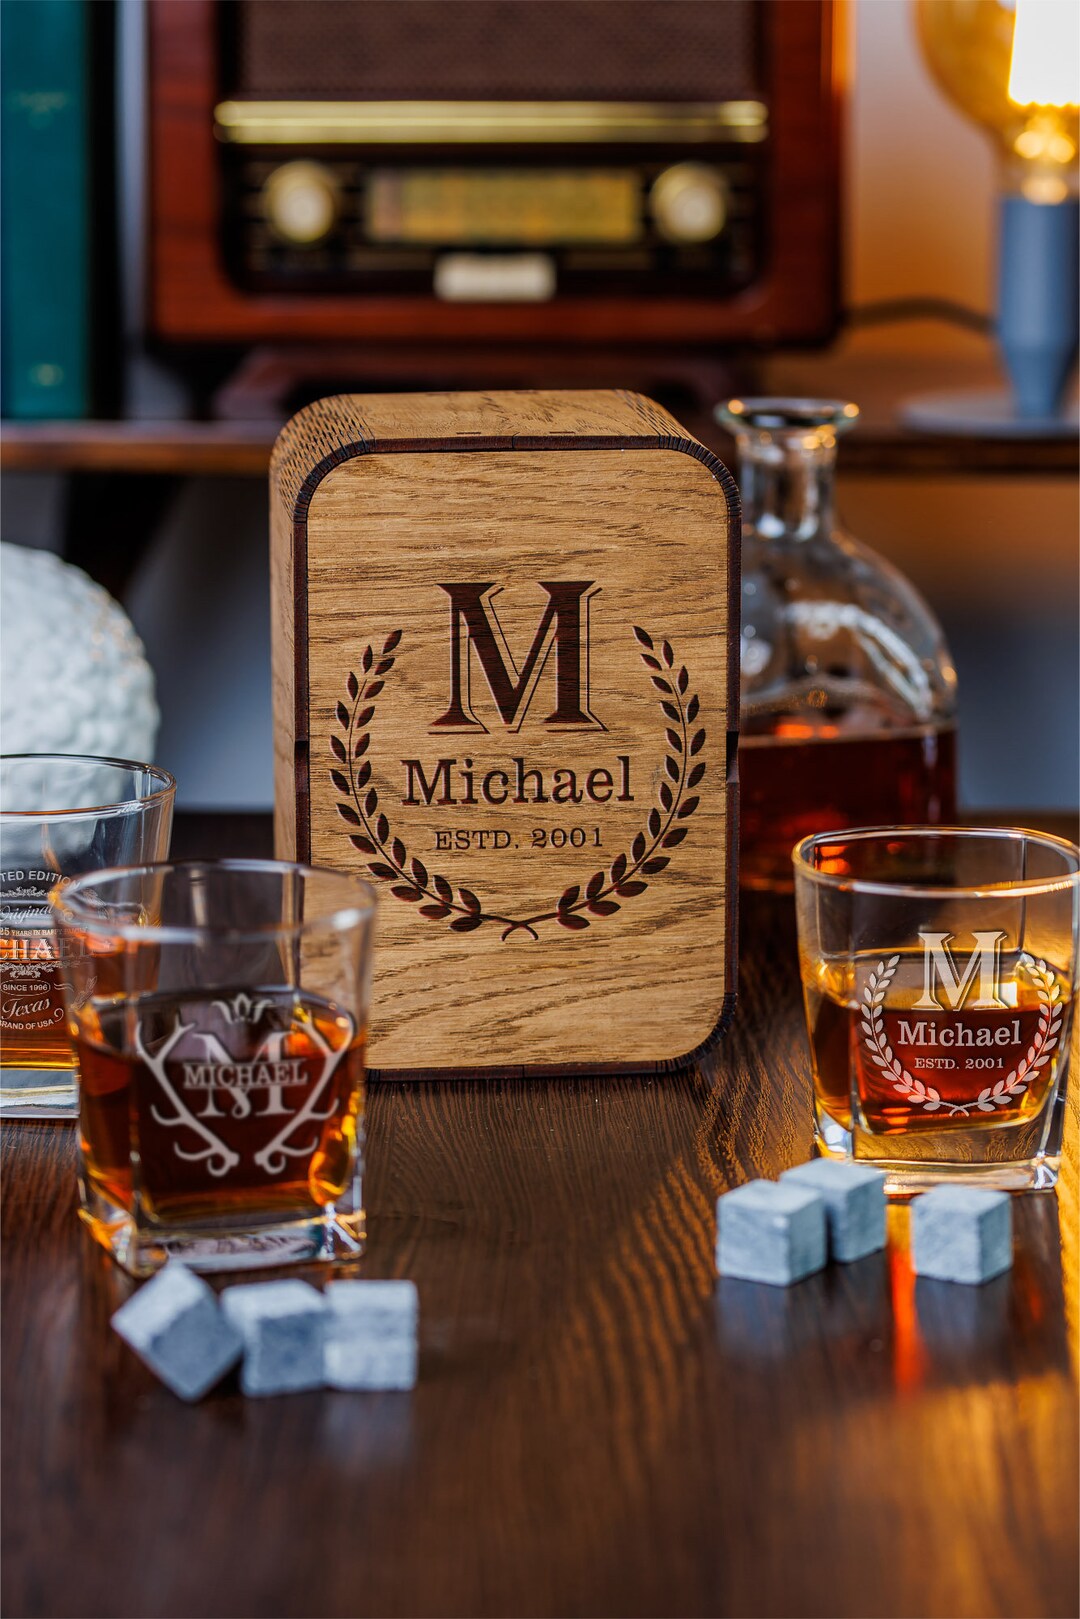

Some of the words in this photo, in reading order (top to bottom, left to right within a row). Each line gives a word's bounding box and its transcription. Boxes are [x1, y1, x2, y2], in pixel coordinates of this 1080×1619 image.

[428, 580, 609, 734] M
[401, 755, 635, 806] Michael
[435, 830, 519, 850] ESTD.
[531, 827, 603, 848] 2001
[911, 931, 1009, 1012] M
[2, 983, 28, 992] SINCE
[29, 983, 49, 991] 1996
[1, 997, 50, 1020] Texas
[25, 1022, 37, 1030] OF
[36, 1018, 55, 1029] USA
[897, 1020, 1022, 1047] Michael
[183, 1058, 308, 1089] MICHAEL
[914, 1057, 960, 1070] ESTD.
[965, 1057, 1004, 1070] 2001
